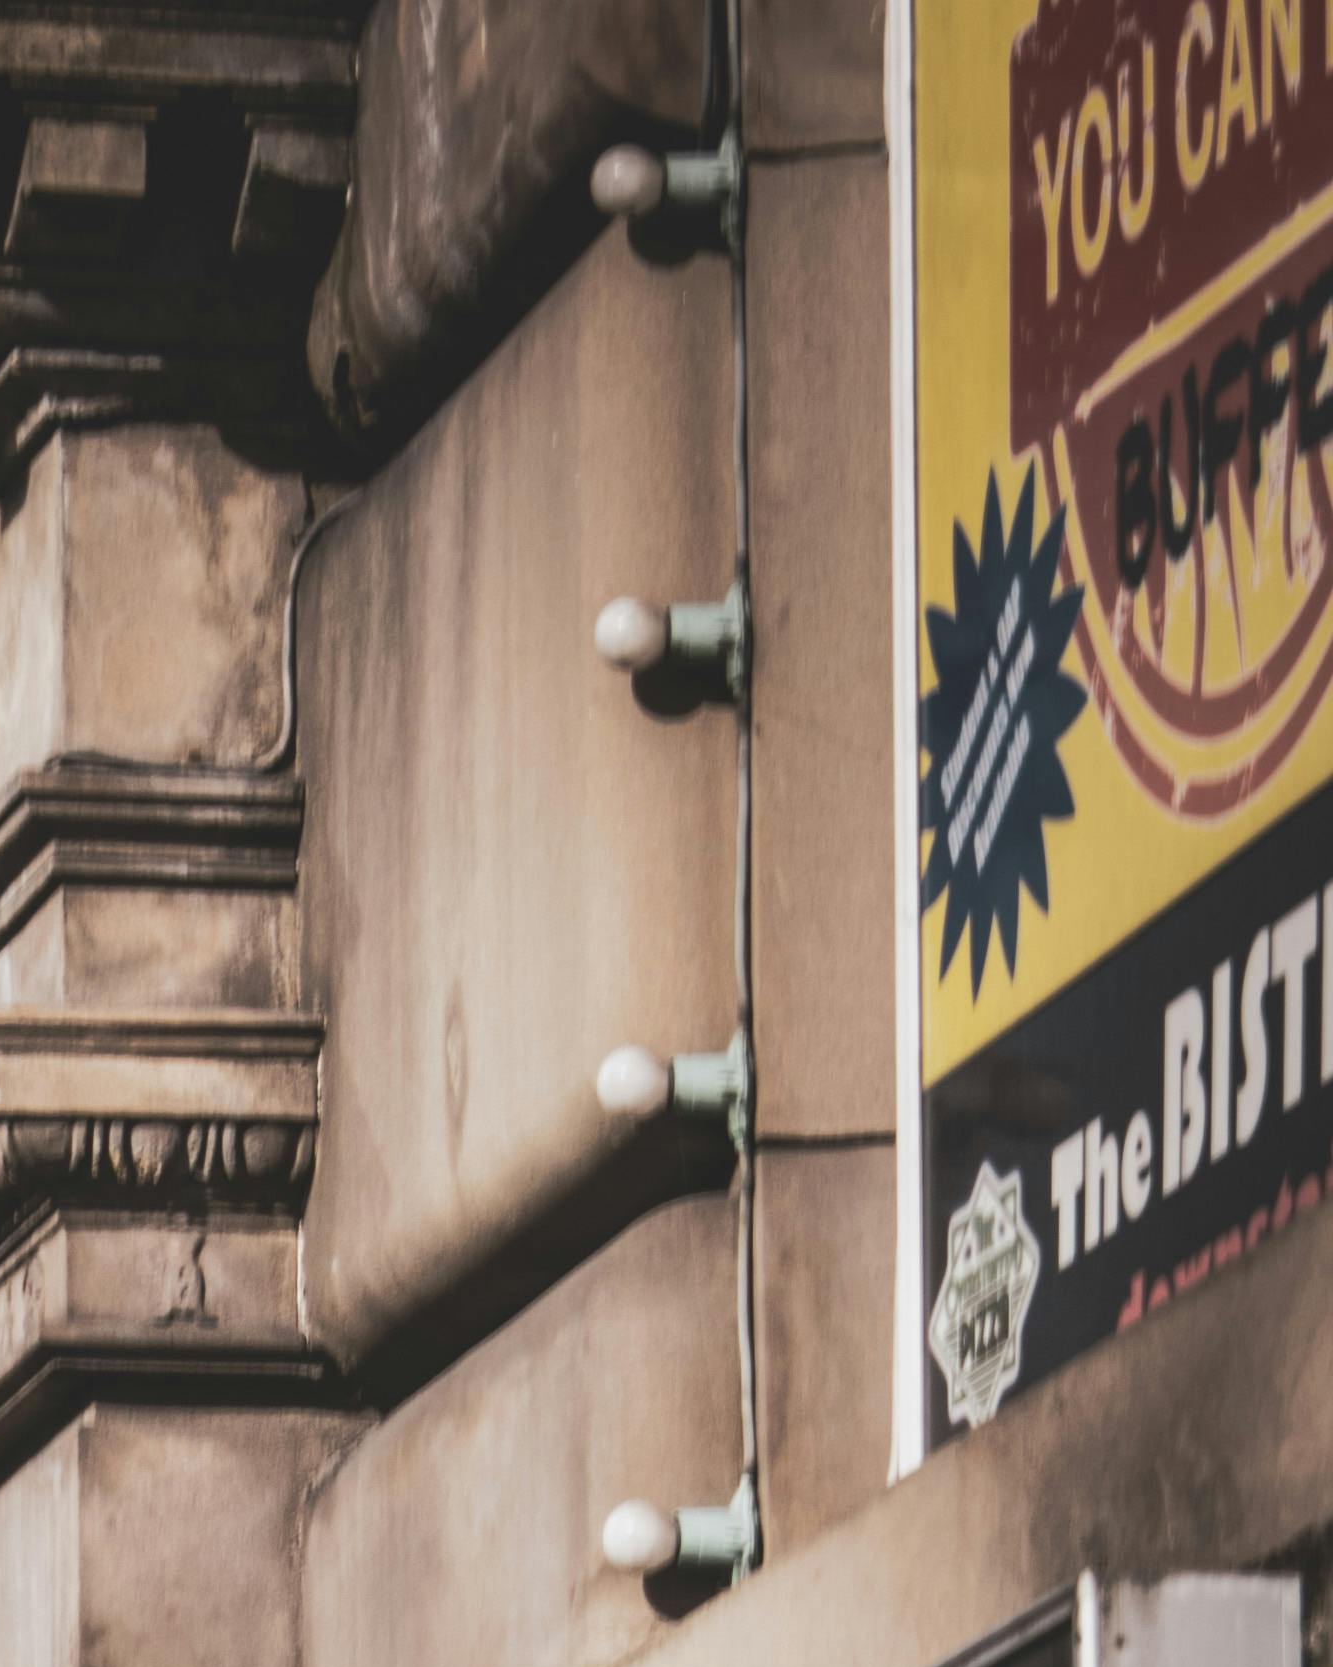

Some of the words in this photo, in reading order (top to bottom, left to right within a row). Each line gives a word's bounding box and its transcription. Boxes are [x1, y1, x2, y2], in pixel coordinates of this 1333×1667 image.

[1034, 42, 1155, 303] YOU
[1175, 0, 1301, 192] CAN
[1051, 1110, 1152, 1273] The
